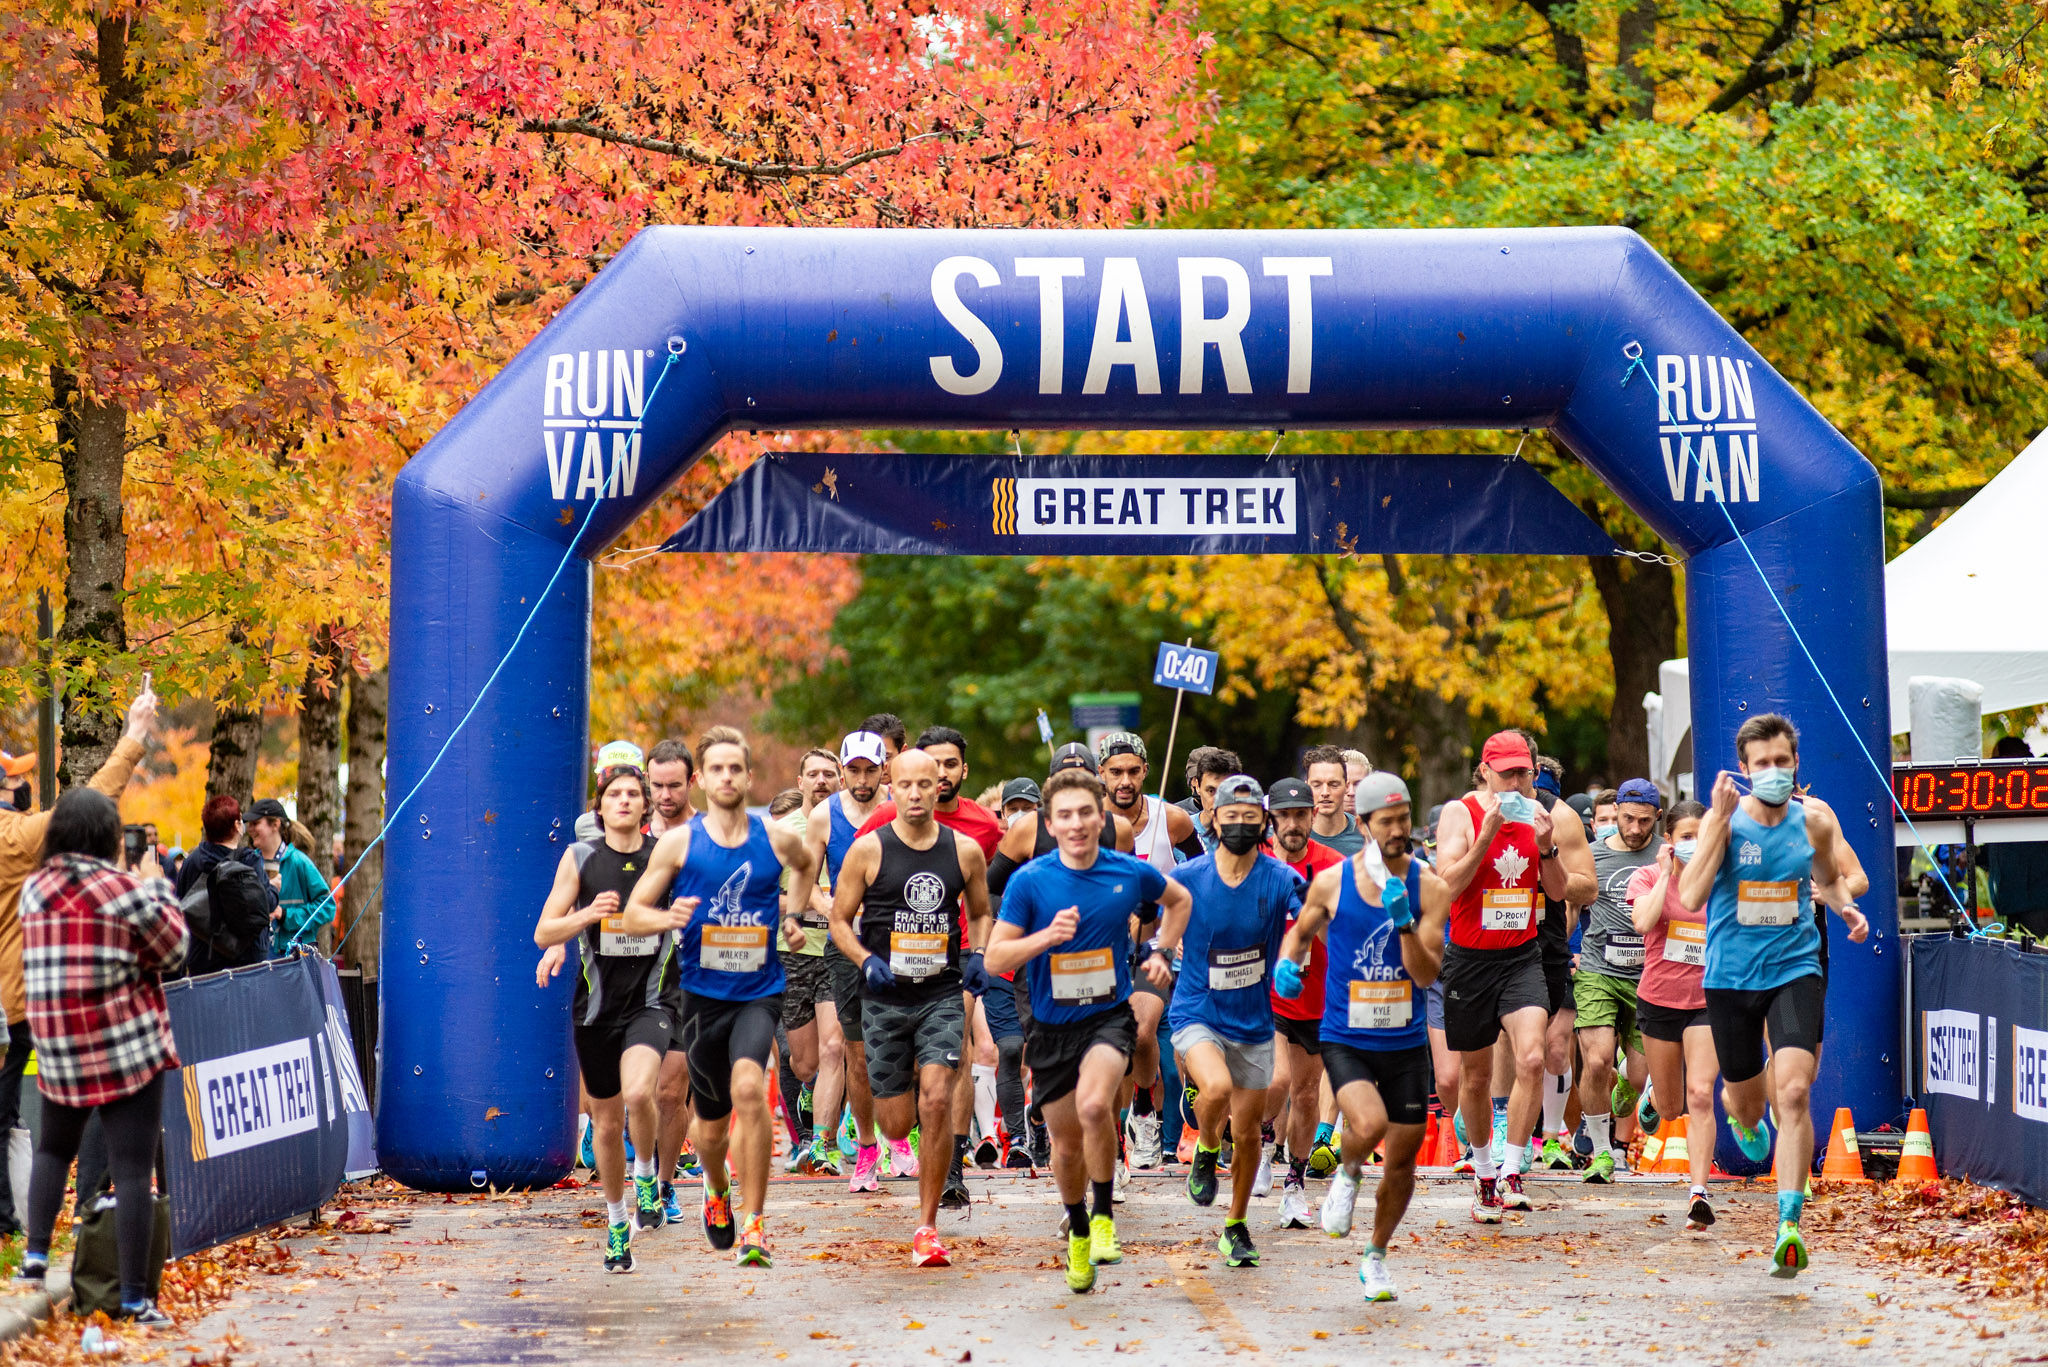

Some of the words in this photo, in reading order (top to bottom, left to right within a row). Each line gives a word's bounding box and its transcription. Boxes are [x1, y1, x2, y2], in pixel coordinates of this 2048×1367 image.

[929, 256, 1333, 395] START
[543, 350, 644, 416] RUN
[1657, 354, 1756, 421] RUN
[543, 431, 642, 499] VAN
[1659, 434, 1760, 502] VAN
[1033, 487, 1166, 525] GREAT
[1179, 487, 1286, 525] TREK
[1163, 650, 1208, 685] 0:40
[1739, 855, 1762, 865] M2M
[719, 912, 763, 927] VFAC
[894, 911, 937, 924] FRASER
[1760, 916, 1777, 924] 2433
[894, 922, 918, 933] RUN
[922, 923, 949, 934] CLUB
[1617, 949, 1645, 957] UMBERTO
[1685, 944, 1702, 954] ANNA
[718, 950, 750, 960] WALKER
[1684, 954, 1699, 963] 2005
[723, 961, 742, 971] 2001
[904, 956, 934, 966] MICHAEL
[911, 967, 927, 976] 2003
[1225, 967, 1253, 978] MICHAEL
[1362, 966, 1403, 981] VFAC
[1076, 987, 1094, 996] 2419
[1373, 1006, 1391, 1015] KYLE
[1373, 1018, 1391, 1027] 2002
[1957, 1027, 1977, 1087] TREK
[208, 1066, 271, 1140] GREAT
[272, 1056, 314, 1123] TREK
